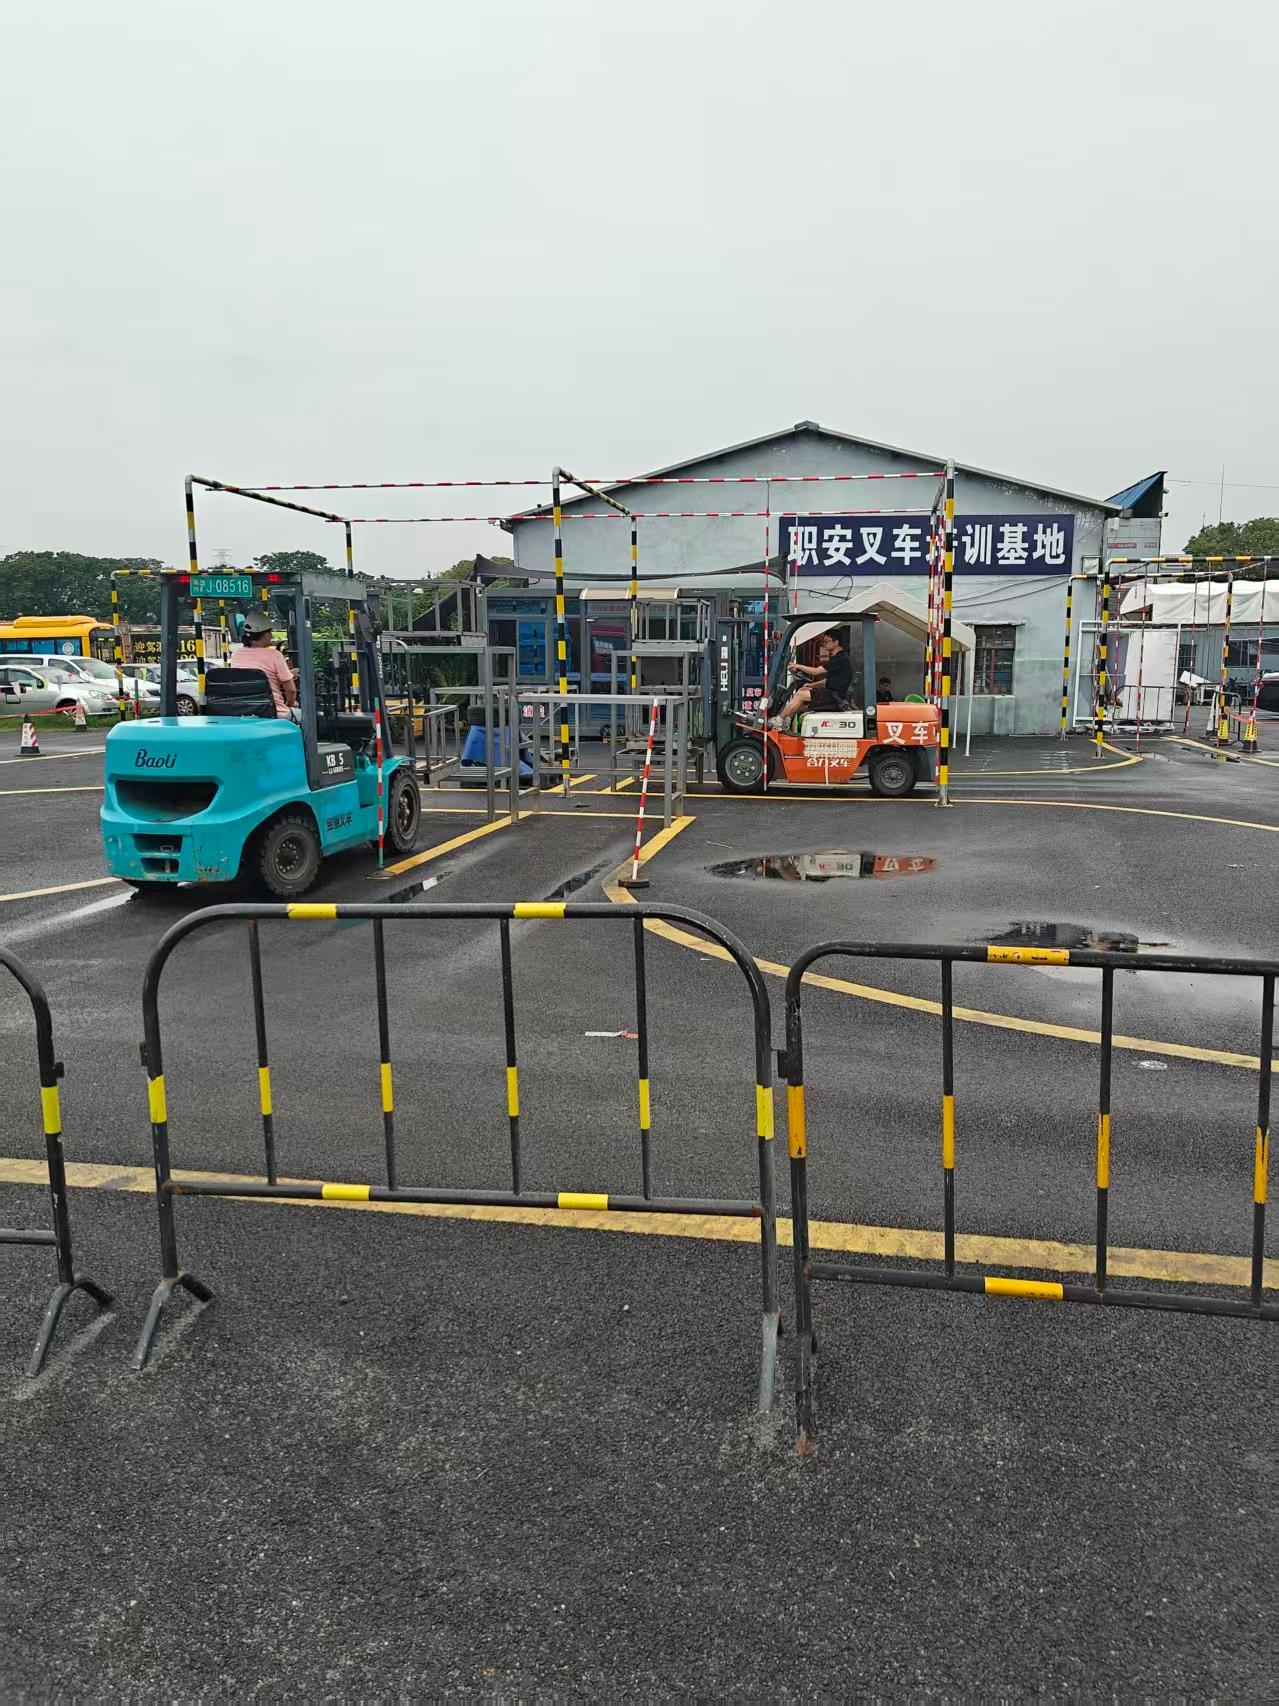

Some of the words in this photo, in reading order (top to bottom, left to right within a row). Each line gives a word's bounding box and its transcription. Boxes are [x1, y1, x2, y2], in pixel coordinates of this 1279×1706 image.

[720, 662, 728, 692] HELI
[882, 722, 936, 745] 叉车
[135, 748, 177, 768] Baoli
[326, 754, 336, 767] KB
